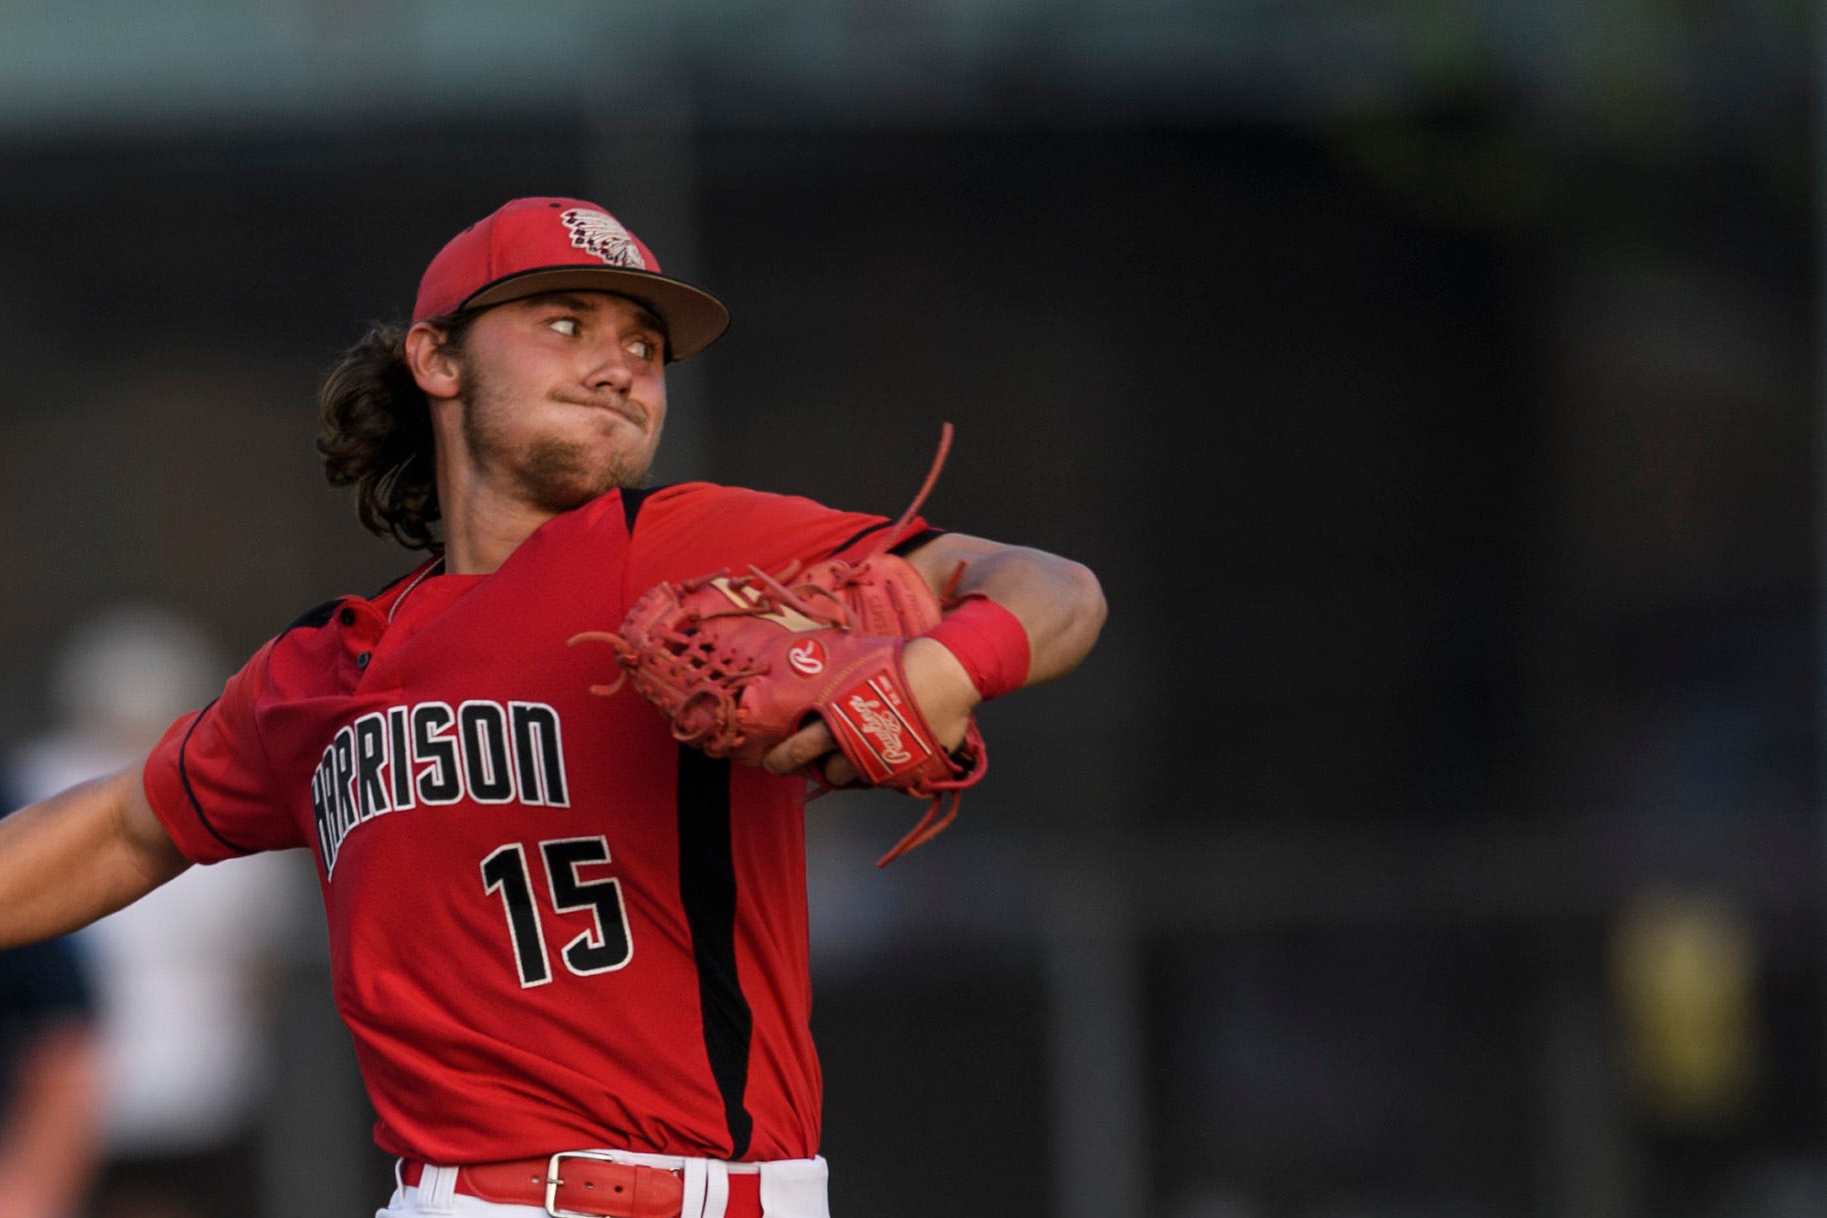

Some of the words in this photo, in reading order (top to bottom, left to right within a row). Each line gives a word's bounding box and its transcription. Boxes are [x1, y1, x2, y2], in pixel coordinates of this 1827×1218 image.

[311, 700, 570, 883] HARRISON
[849, 695, 911, 763] Rawlings
[480, 835, 633, 988] 15
